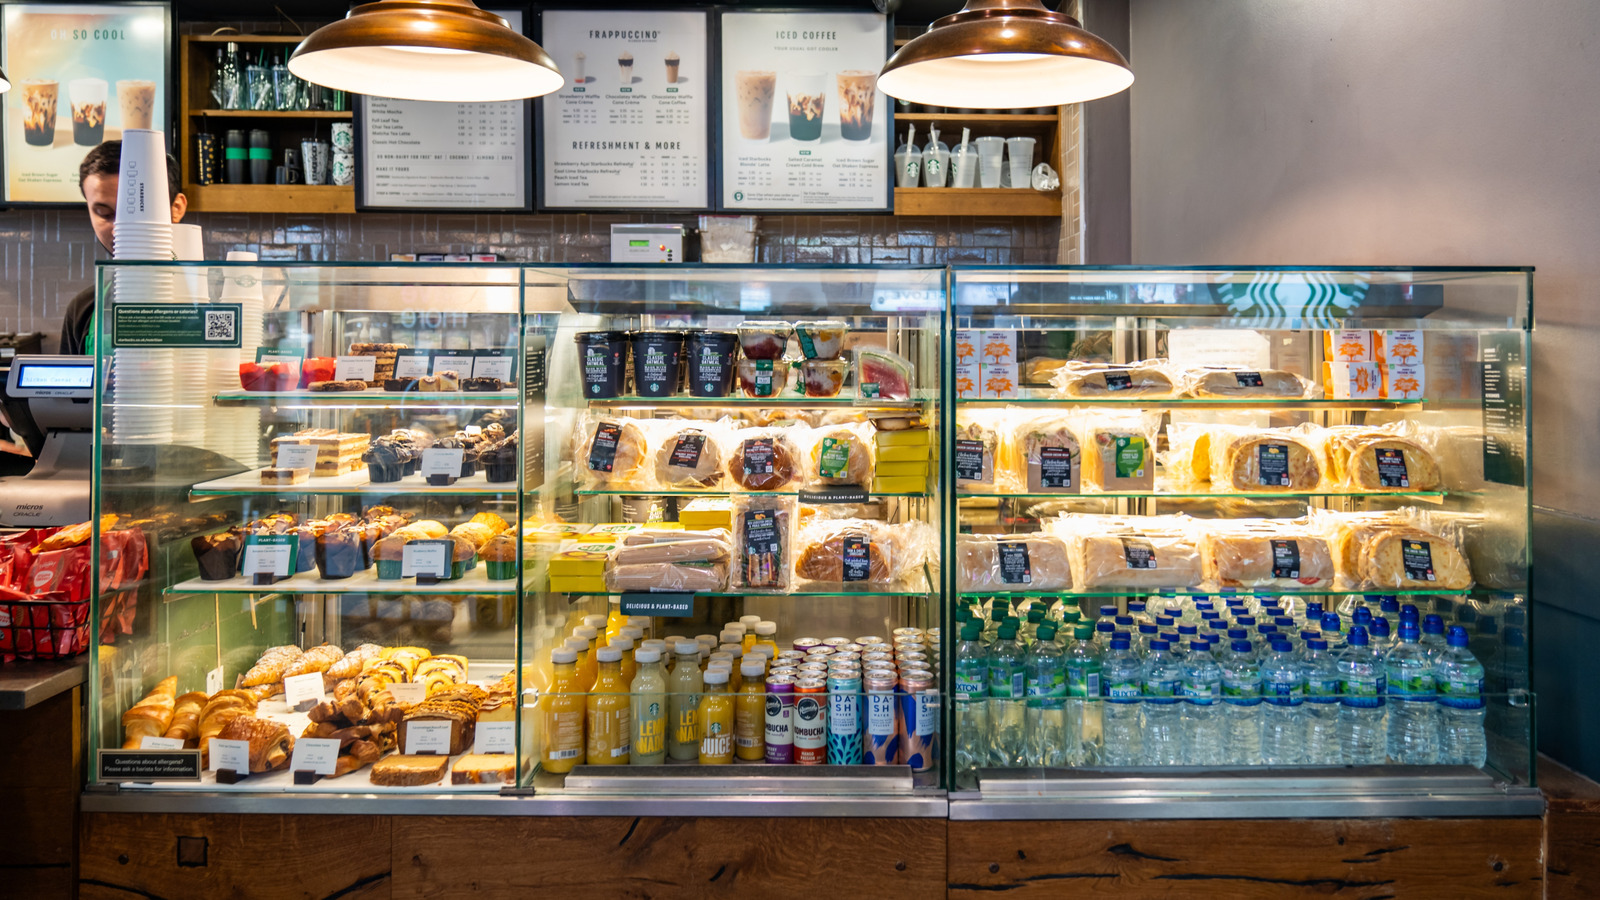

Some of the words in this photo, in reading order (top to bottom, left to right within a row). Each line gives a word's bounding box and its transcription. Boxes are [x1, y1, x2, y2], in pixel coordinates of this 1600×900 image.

[51, 30, 67, 40] OH
[73, 30, 88, 40] SO
[94, 30, 125, 40] COOL
[776, 31, 798, 40] ICED
[803, 31, 836, 40] COFFEE
[572, 142, 639, 150] REFRESHMENT
[644, 142, 650, 150] &
[656, 142, 681, 150] MORE
[701, 736, 731, 754] JUICE
[157, 758, 184, 766] allergens?
